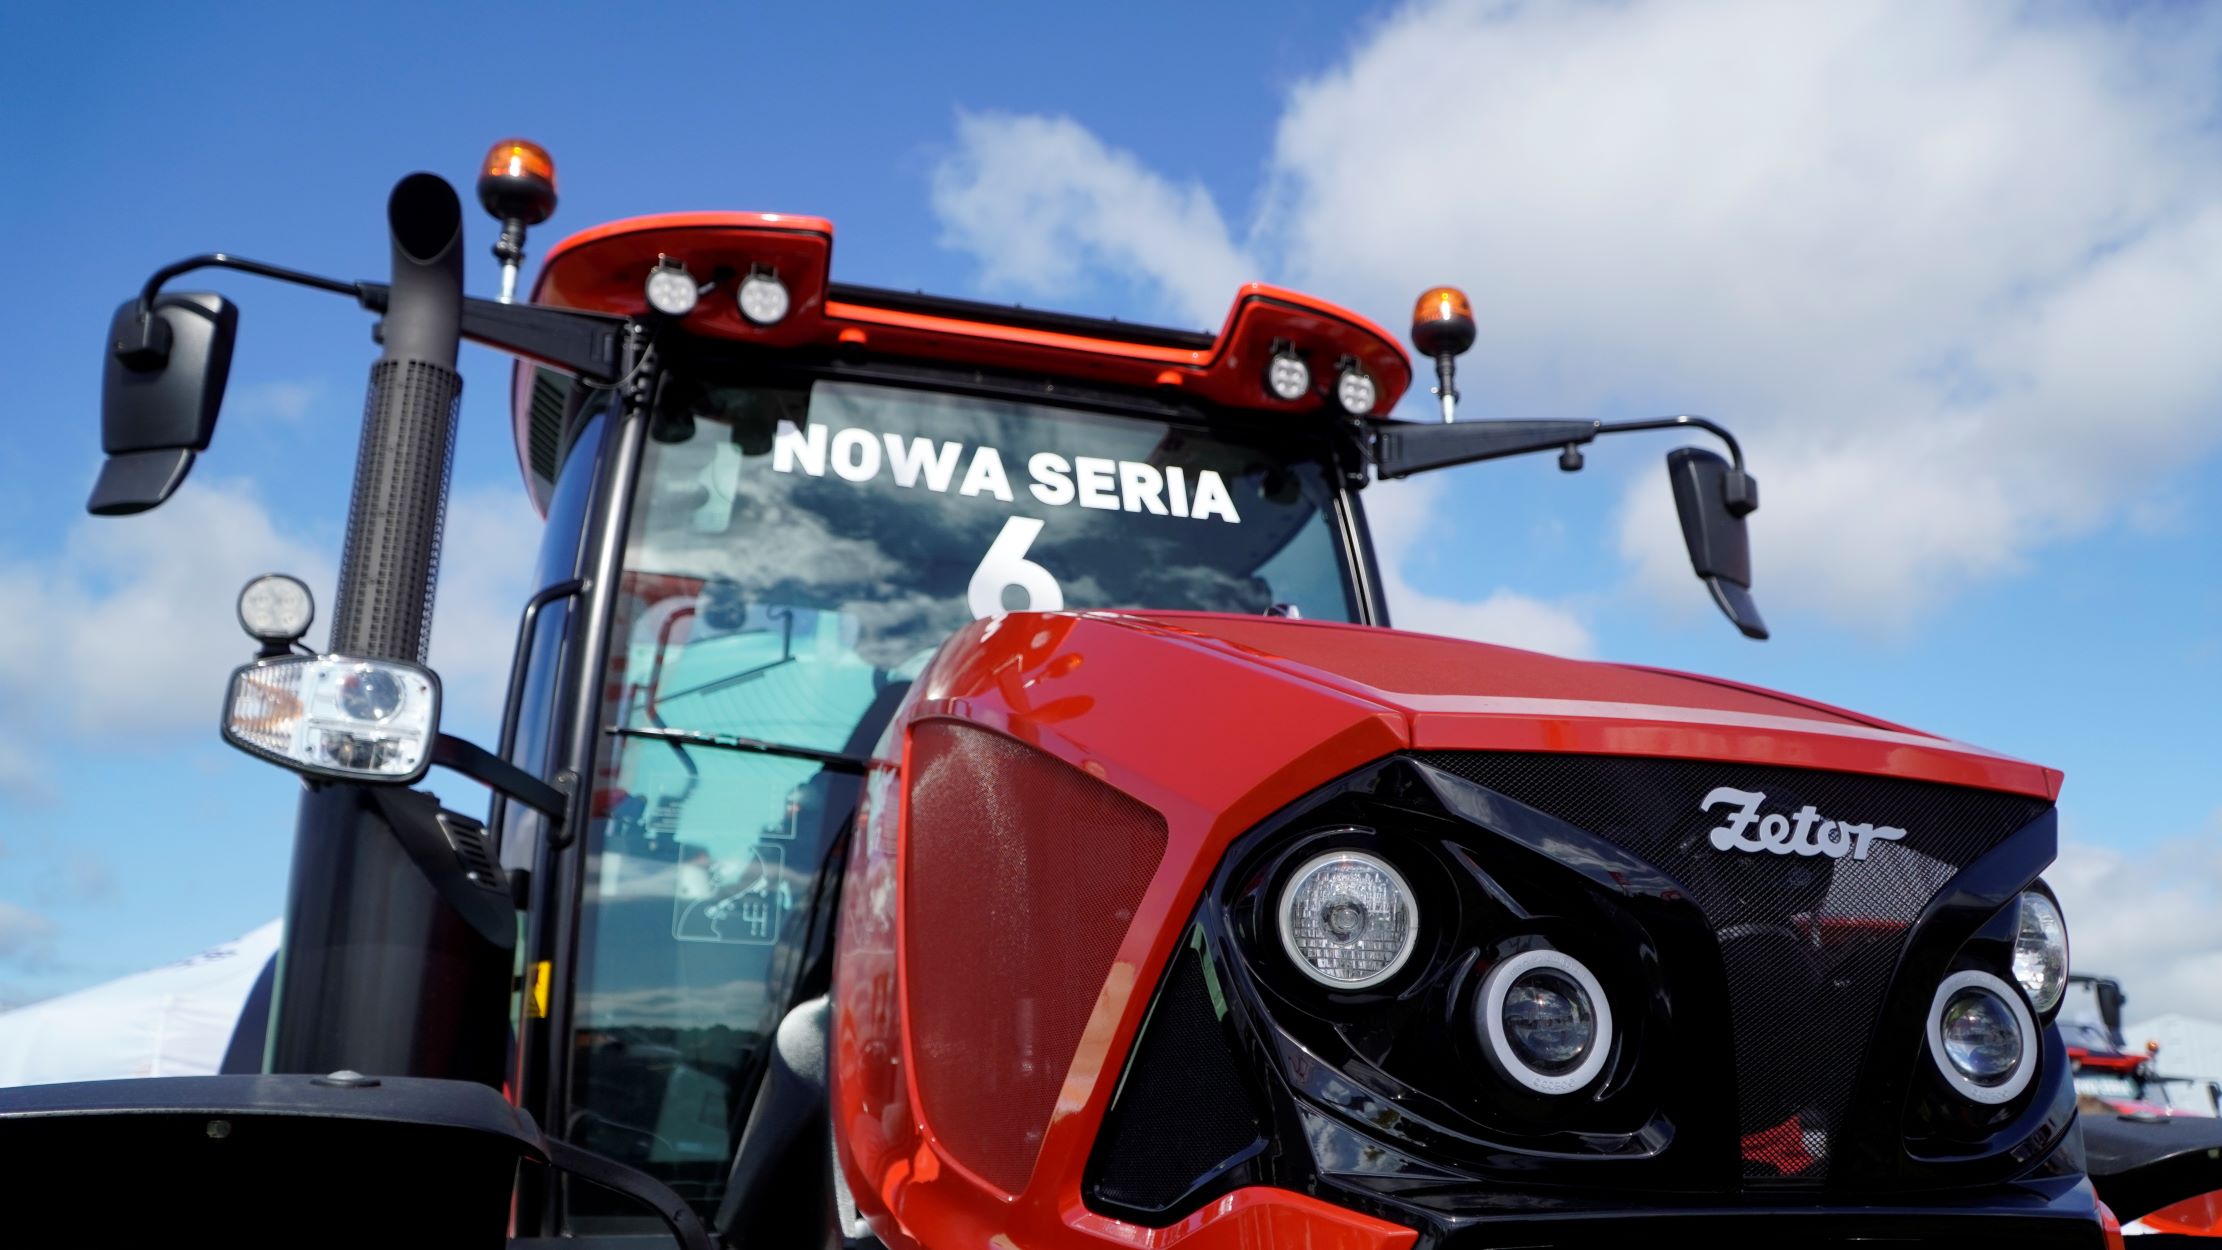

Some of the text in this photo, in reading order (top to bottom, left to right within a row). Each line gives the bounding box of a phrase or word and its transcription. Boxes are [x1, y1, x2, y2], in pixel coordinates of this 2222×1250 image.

[772, 419, 1241, 523] NOWA SERIA
[967, 515, 1064, 622] 6
[1701, 786, 1907, 861] Zetor
